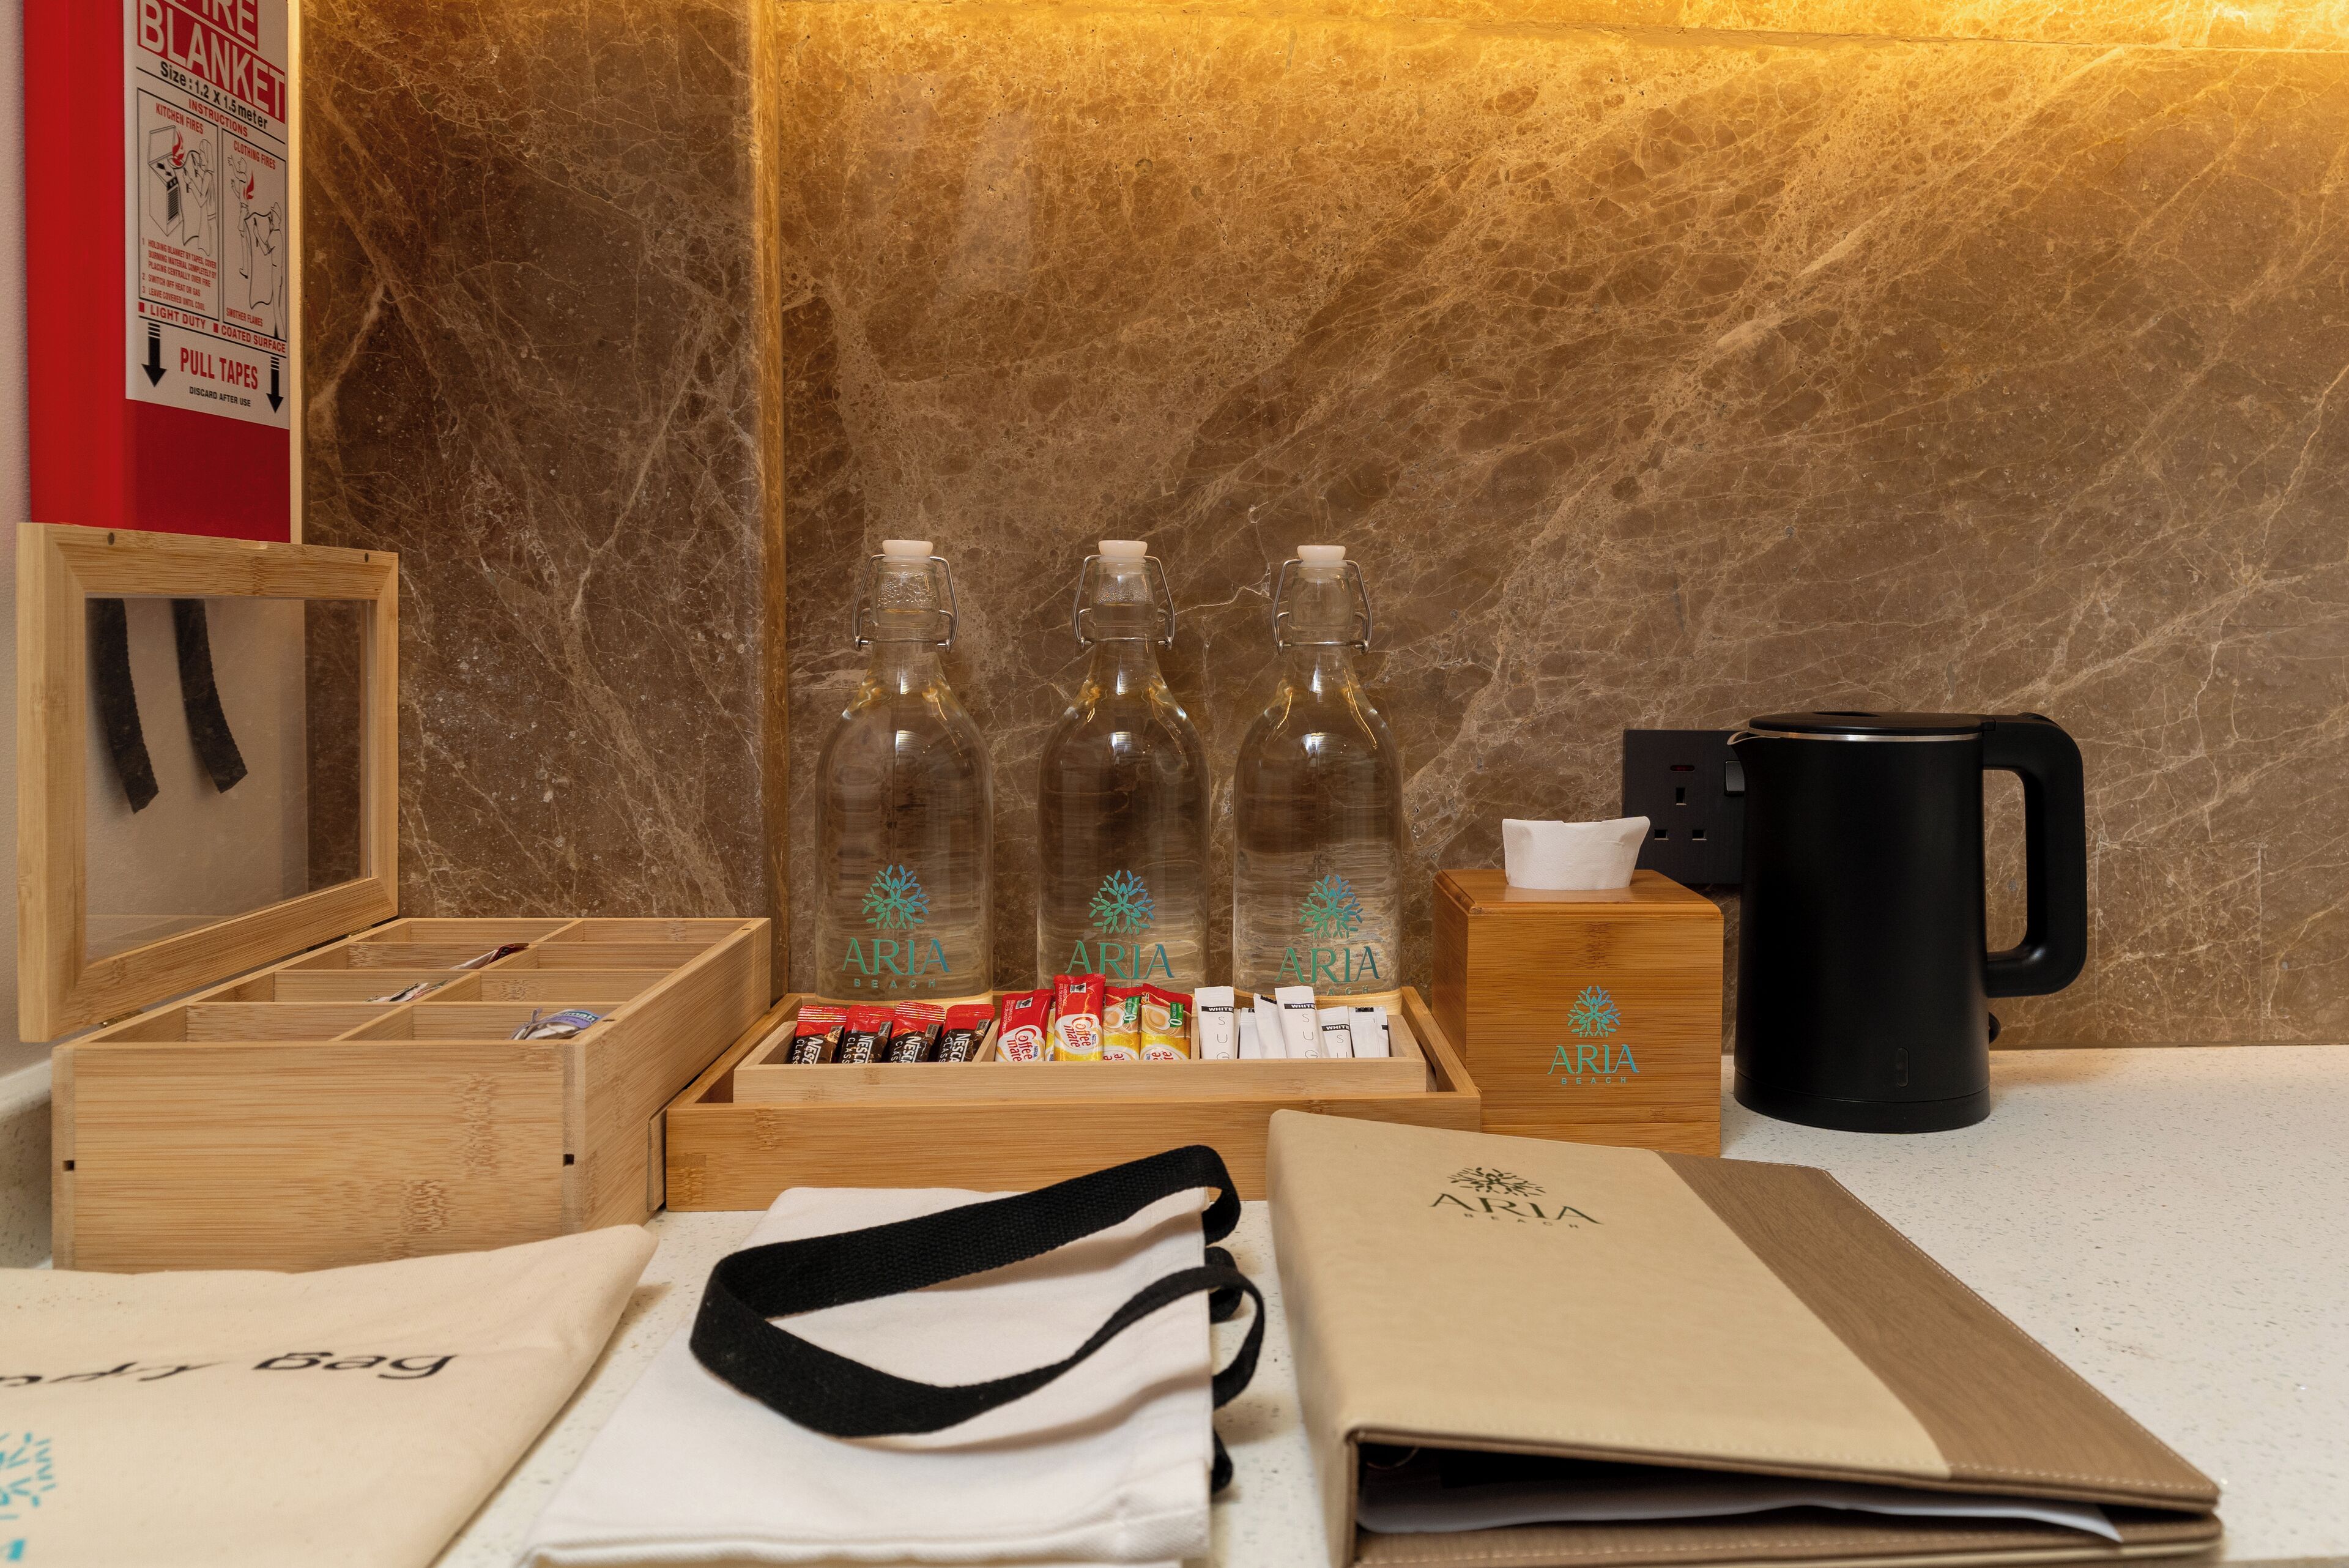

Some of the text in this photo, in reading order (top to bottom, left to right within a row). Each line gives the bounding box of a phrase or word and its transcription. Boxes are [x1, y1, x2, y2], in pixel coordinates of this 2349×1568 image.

[139, 0, 285, 119] BLANKET
[155, 102, 204, 135] KITCHEN FIRES
[188, 98, 248, 138] INSTRUCTIONS
[234, 140, 276, 170] CLOTHING FIRES
[148, 239, 167, 252] HOLDING
[168, 245, 185, 258] BLANKET
[148, 250, 167, 263] BURNING
[168, 256, 187, 270] MATERIAL
[148, 261, 211, 288] PLACING CENTRALLY OVER FIRE
[148, 274, 165, 286] SWITCH
[166, 279, 174, 289] OFF
[175, 281, 185, 292] HEAT
[148, 287, 162, 299] LEAVE
[163, 291, 182, 304] COVERED
[182, 297, 194, 308] UNTIL
[150, 305, 206, 330] LIGHT DUTY
[226, 307, 263, 327] SMOTHER FLAMES
[221, 325, 286, 354] COATED SURFACE
[180, 347, 258, 390] PULL TAPES
[189, 386, 251, 407] DISCARD AFTER USE
[841, 937, 952, 976] ARIA
[1065, 940, 1175, 979] ARIA
[1274, 945, 1381, 984] ARIA
[853, 978, 937, 989] BEACH
[1326, 985, 1369, 996] ACH
[1015, 1028, 1037, 1060] Coffee
[1063, 1025, 1081, 1048] mate
[1071, 1016, 1094, 1047] Coffee
[801, 1036, 823, 1064] NESC
[1547, 1044, 1640, 1075] ARIA
[1428, 1193, 1603, 1225] ARIA
[1464, 1213, 1579, 1229] BEACH
[251, 1352, 457, 1380] Bag
